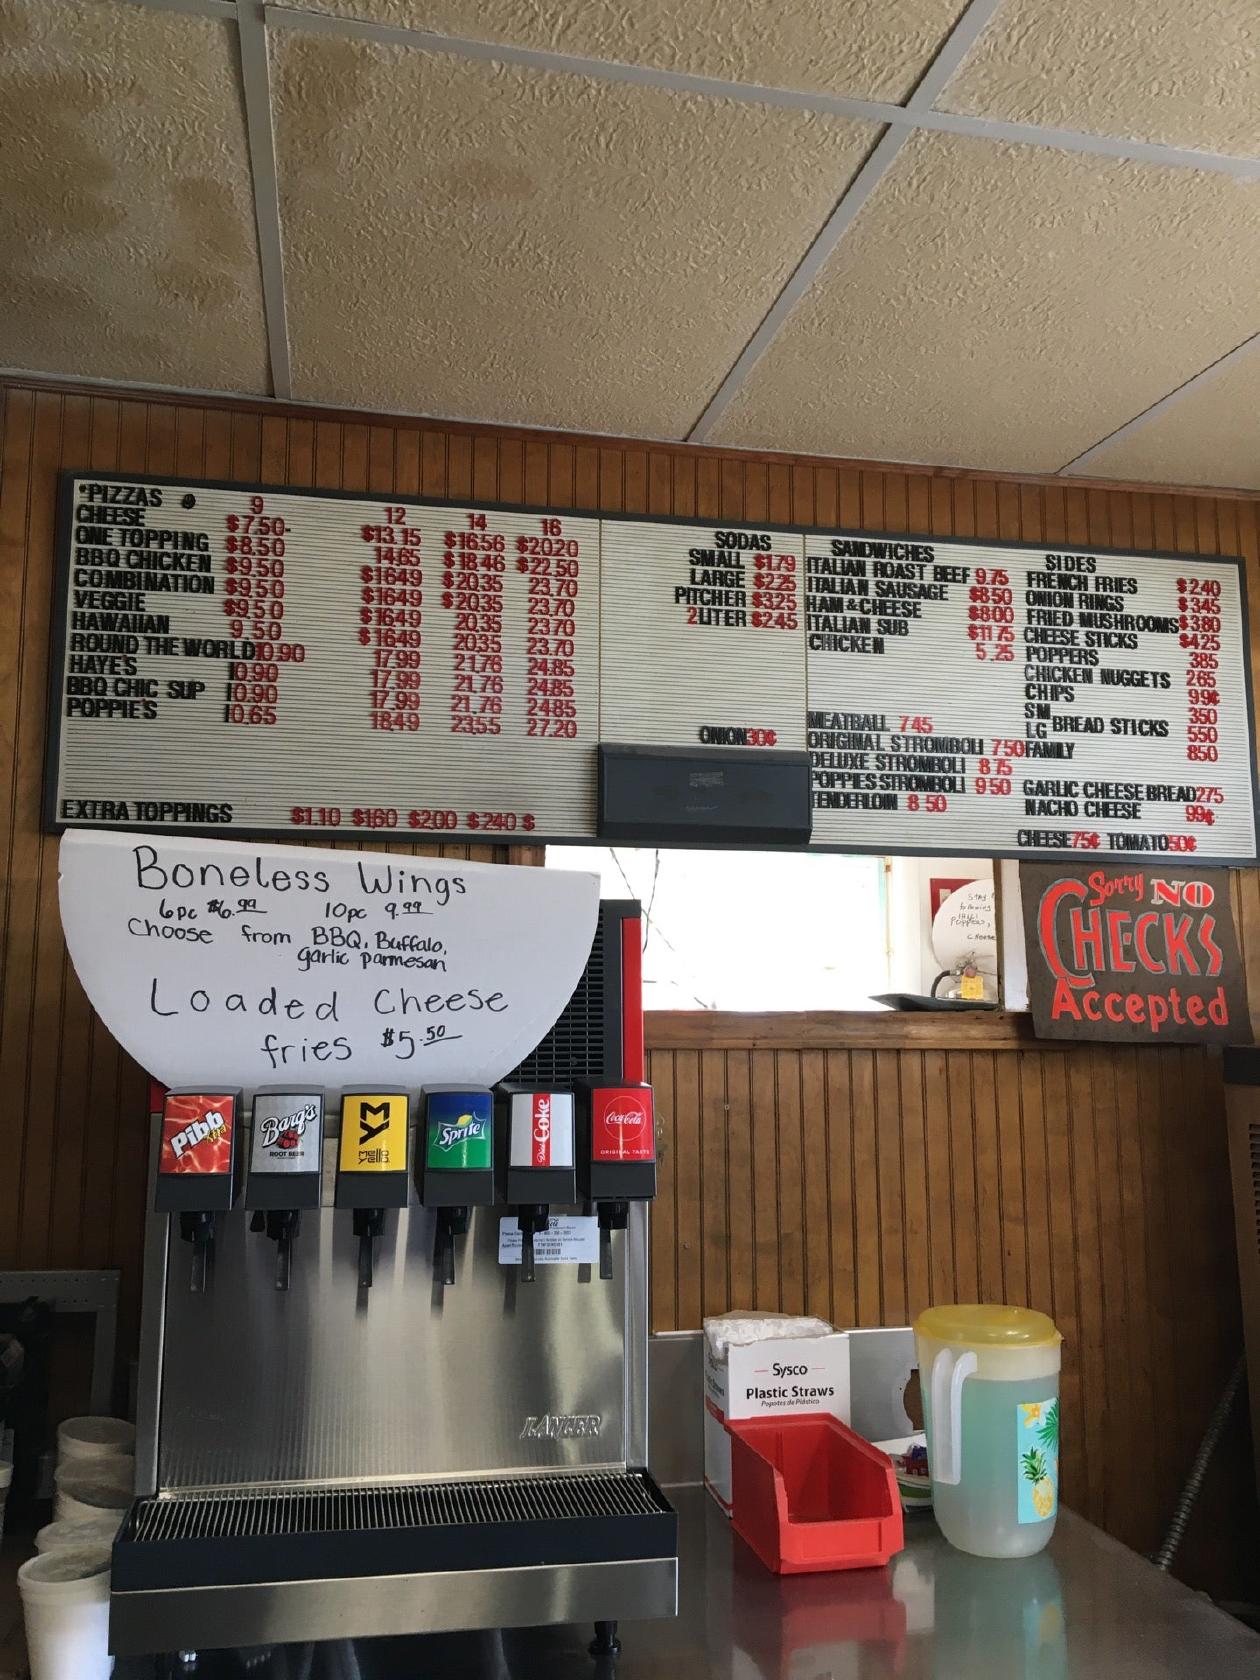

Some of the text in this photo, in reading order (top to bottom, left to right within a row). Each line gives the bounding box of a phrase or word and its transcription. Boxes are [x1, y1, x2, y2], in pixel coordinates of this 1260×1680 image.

[76, 504, 146, 527] CHEESE
[88, 484, 561, 536] PIZZAS 9 12 14 16
[76, 526, 113, 546] ONE
[121, 529, 209, 552] TOPPING
[225, 535, 285, 557] $8.50
[715, 531, 772, 551] SODAS
[831, 540, 935, 563] SANDWICHES
[689, 548, 745, 569] SMALL
[807, 557, 866, 577] ITALIAN
[873, 560, 927, 581] ROAST
[933, 565, 971, 584] BEEF
[1045, 554, 1096, 574] SIDES
[75, 548, 121, 567] BBQ
[127, 550, 212, 573] CHICKEN
[225, 556, 284, 578] $9.50
[529, 577, 577, 597] 23.70
[690, 568, 745, 588] LARGE
[1026, 571, 1138, 595] FRENCH FRIES
[74, 568, 215, 594] COMBINATION
[225, 577, 284, 598] $9.50
[528, 597, 575, 617] 23.70
[674, 586, 746, 608] PITCHER
[808, 576, 949, 601] ITALIAN SAUSAGE
[74, 590, 502, 633] VEGGIE $9.50 20.35
[807, 595, 844, 613] HAM
[860, 598, 922, 618] CHEESE
[1025, 590, 1124, 612] ONION RINGS
[71, 611, 170, 634] HAWAIIAN
[229, 619, 281, 640] 9.50
[807, 614, 909, 636] ITALIAN SUB
[1027, 608, 1179, 634] FRIED MUSHROOMS
[809, 634, 885, 654] CHICKEN
[1024, 627, 1138, 650] CHEESE STICKS
[70, 633, 139, 655] ROUND
[144, 636, 179, 656] THE
[183, 638, 255, 659] WORLD
[374, 649, 421, 669] 17.99
[454, 654, 502, 673] 21.76
[1025, 645, 1099, 666] POPPERS
[370, 669, 421, 689] 17.99
[454, 674, 503, 694] 21.76
[1024, 664, 1093, 684] CHICKEN
[1101, 668, 1171, 690] NUGGETS
[67, 676, 502, 714] BBQ CHIC 17.99 21.76
[1025, 684, 1075, 703] CHIPS
[369, 711, 420, 732] 18.49
[451, 715, 501, 735] 23.55
[808, 711, 890, 732] MEATBALL
[1026, 721, 1047, 739] LG
[1053, 716, 1169, 738] BREAD STICKS
[808, 731, 984, 755] ORIGINAL STROMBOLI
[1025, 742, 1075, 760] FAMILY
[811, 751, 966, 774] DELUXE STROMBOLI
[1023, 780, 1080, 799] GARLIC
[1083, 781, 1145, 801] CHEESE
[1146, 784, 1196, 803] BREAD
[61, 800, 130, 821] EXTRA
[135, 802, 233, 823] TOPPINGS
[1025, 799, 1079, 817] NACHO
[1084, 801, 1142, 819] CHEESE
[1018, 829, 1072, 848] CHEESE
[1107, 832, 1168, 851] TOMATO
[132, 845, 466, 906] Boneless Wings
[1088, 870, 1215, 908] Sorry NO
[325, 902, 367, 923] 10pc
[128, 918, 214, 944] Choose
[241, 925, 291, 945] from
[375, 930, 448, 955] Buffalo,
[1037, 877, 1223, 989] CHECKS
[298, 947, 447, 973] garlic parmesan
[150, 977, 509, 1023] Loaded Cheese
[1052, 978, 1229, 1032] Accepted
[260, 1034, 353, 1069] fries
[533, 1099, 550, 1143] Coke
[170, 1110, 225, 1159] Pibb
[439, 1121, 481, 1146] Sprite
[772, 1362, 808, 1378] Sysco
[746, 1385, 834, 1399] Plastic Straws
